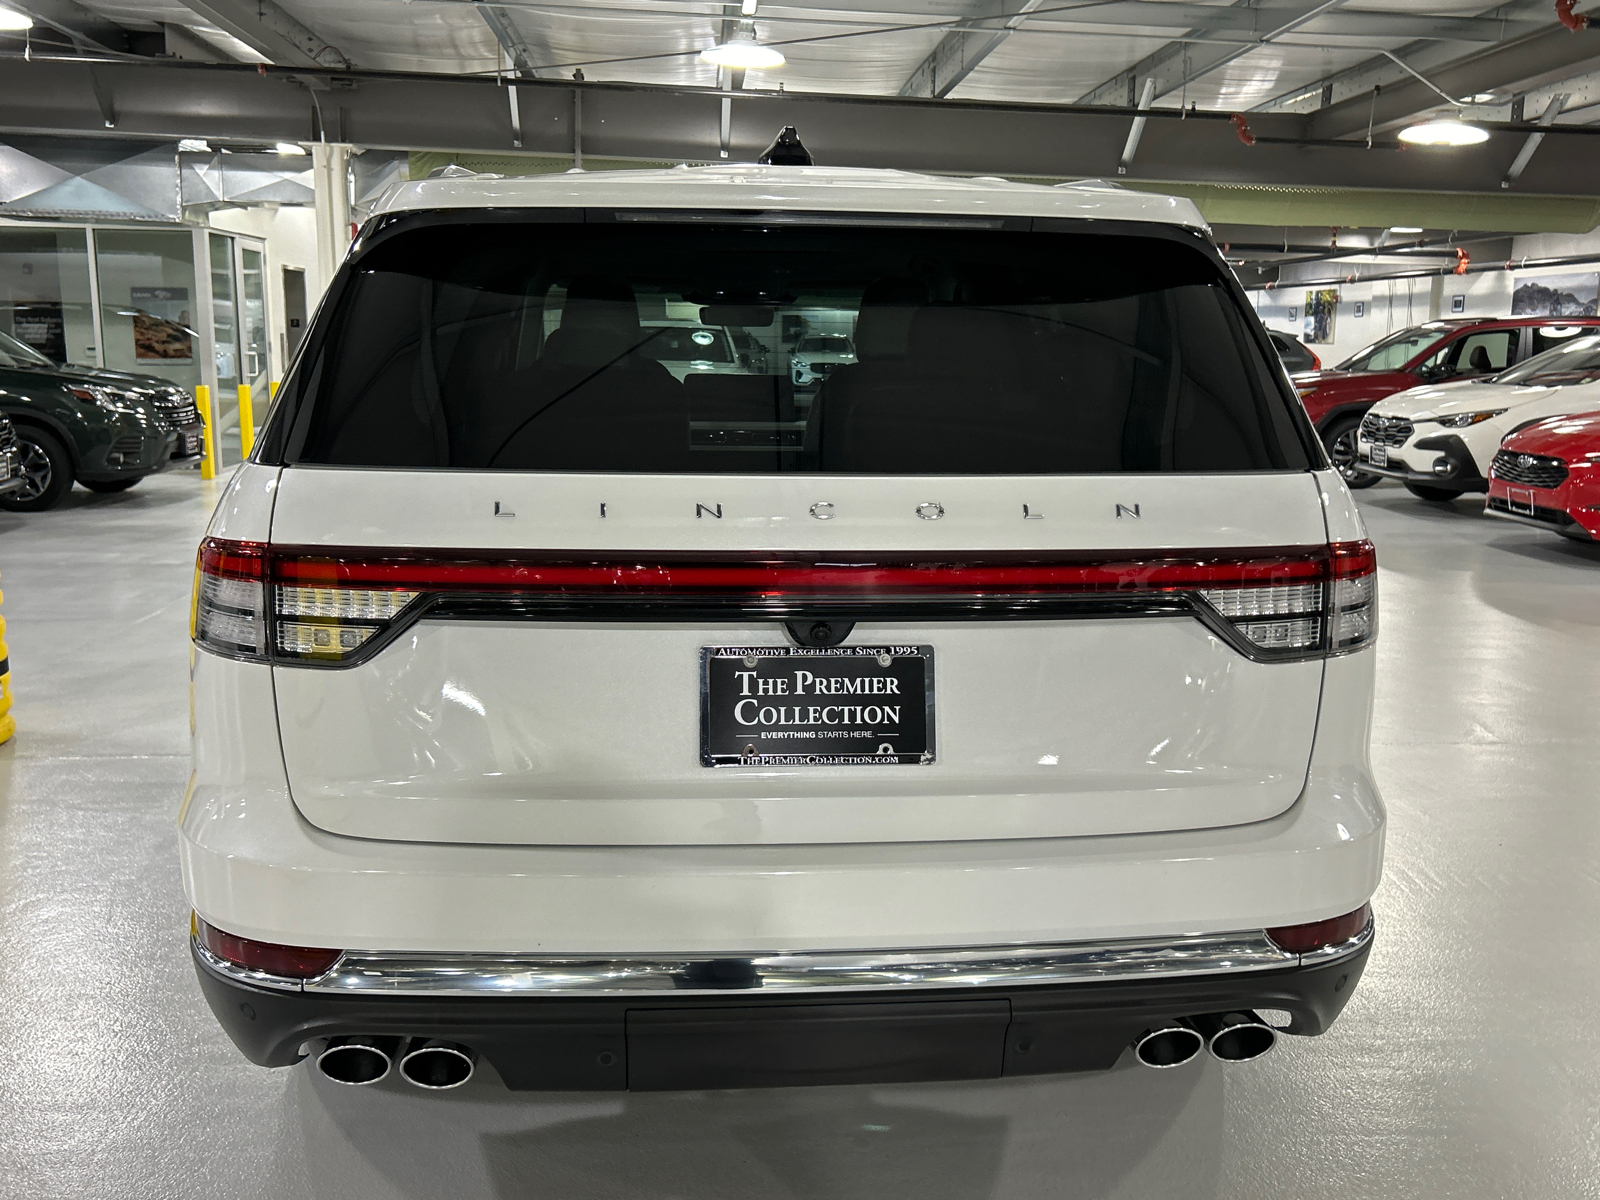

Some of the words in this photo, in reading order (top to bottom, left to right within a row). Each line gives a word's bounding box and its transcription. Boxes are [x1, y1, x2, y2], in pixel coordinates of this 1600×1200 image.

[494, 501, 1141, 520] LINCOLN
[718, 647, 786, 656] AUTOMOTIVE
[789, 646, 853, 656] EXCELLENCE
[855, 646, 886, 656] SINCE
[889, 646, 918, 655] 1995
[734, 670, 789, 696] THE
[794, 670, 901, 695] PREMIER
[734, 698, 901, 726] COLLECTION
[761, 731, 816, 739] EVERYTHING
[817, 731, 849, 739] STARTS
